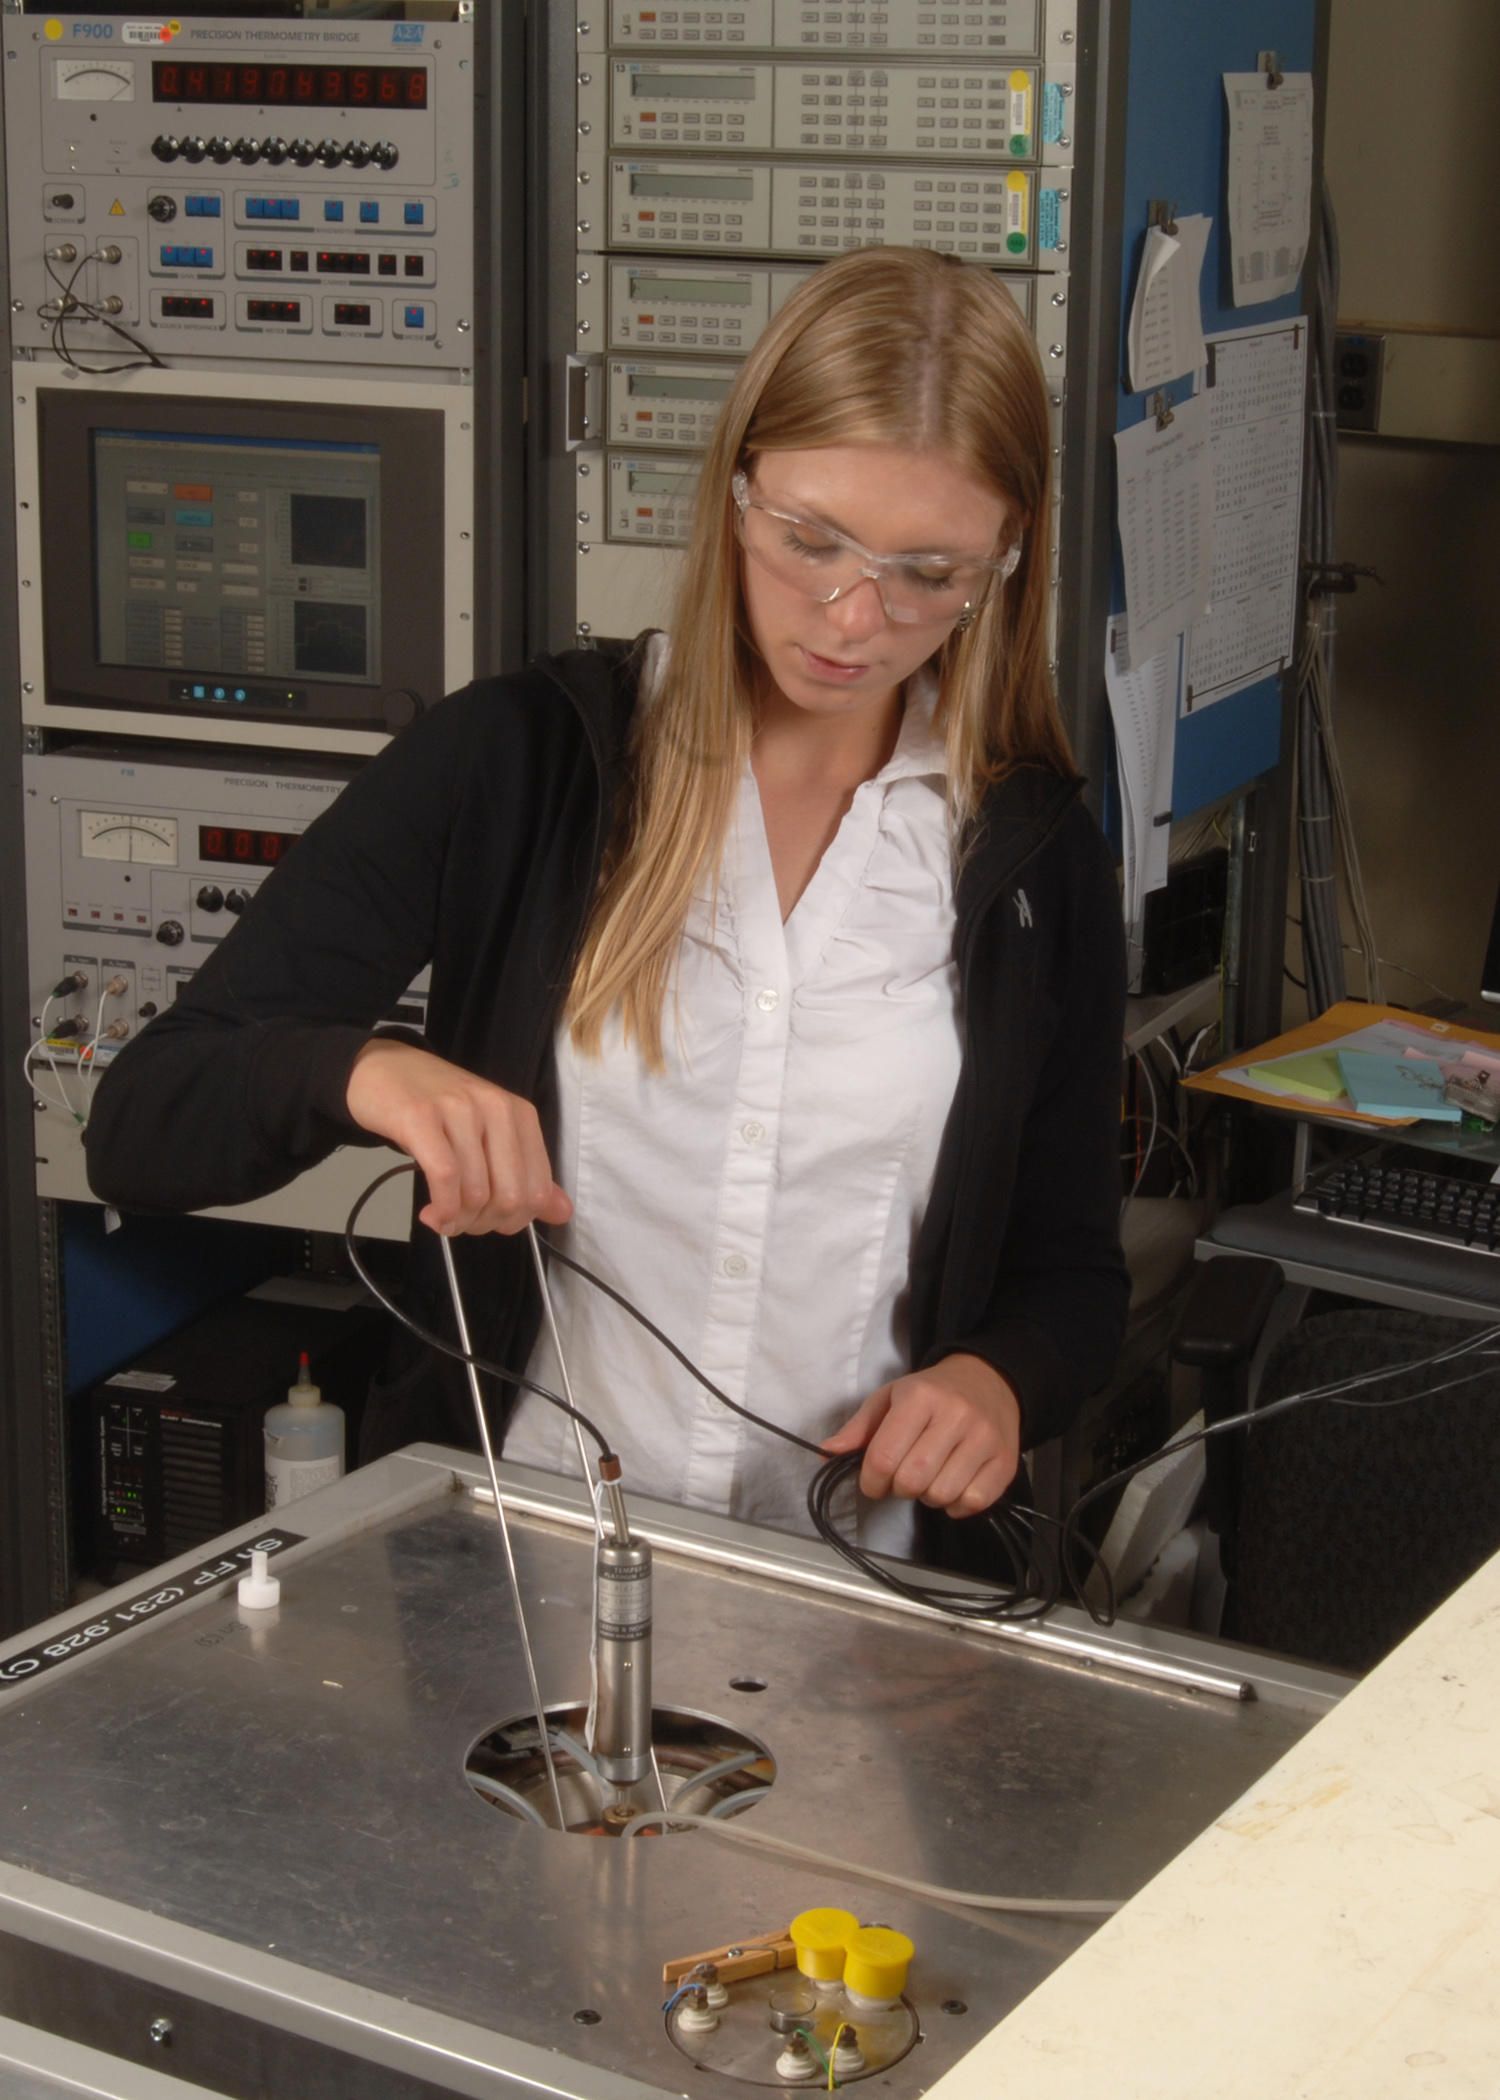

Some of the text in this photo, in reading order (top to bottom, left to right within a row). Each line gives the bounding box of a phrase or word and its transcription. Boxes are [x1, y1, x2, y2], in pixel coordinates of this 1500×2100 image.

[72, 22, 114, 39] F900
[190, 30, 361, 42] PRECISION THERMOMETRY BRIDGE
[224, 777, 269, 788] PRECISION
[192, 1561, 238, 1586] FP
